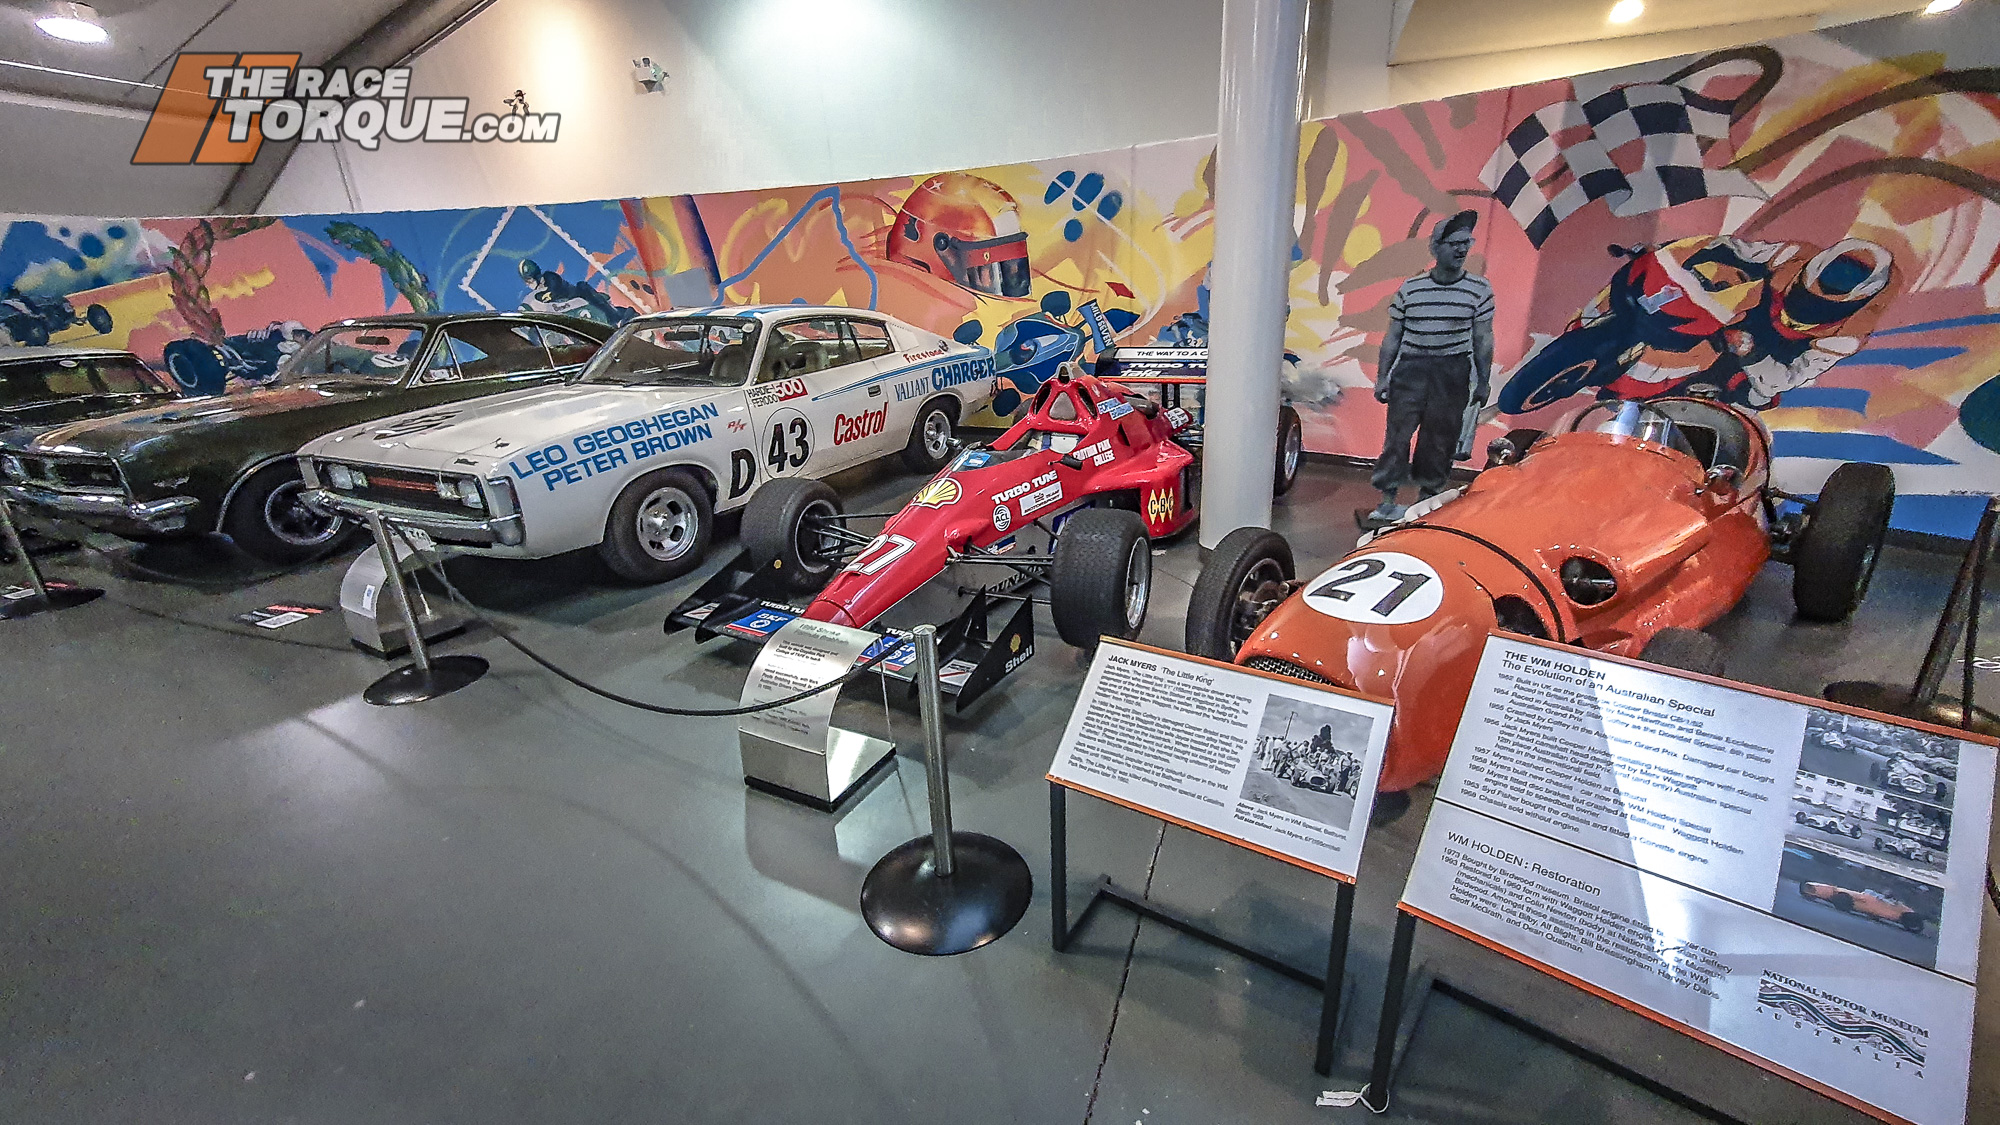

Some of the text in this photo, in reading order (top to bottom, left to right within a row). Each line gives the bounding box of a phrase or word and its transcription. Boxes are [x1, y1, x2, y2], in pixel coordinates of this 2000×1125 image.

[774, 379, 804, 398] 500
[894, 356, 996, 402] VALIANT CHARGER
[509, 402, 719, 479] LEO GEOGHEGAN
[768, 417, 809, 473] 43
[834, 402, 888, 446] Castrol
[543, 422, 712, 491] PETER BROWN
[729, 448, 756, 500] D
[991, 481, 1031, 504] TURBO
[1032, 470, 1058, 488] TUNE
[995, 513, 1010, 524] ACL
[841, 533, 917, 576] 27
[1307, 559, 1432, 617] 21
[1004, 645, 1034, 674] Shell
[1108, 655, 1129, 665] JACK
[1130, 660, 1157, 671] MYERS
[1177, 671, 1194, 680] Little
[1504, 651, 1605, 680] THE WM HOLDEN
[1501, 660, 1715, 718] The Evolution of an Australian Special
[1502, 722, 1518, 731] Jack
[1519, 728, 1541, 738] Myers
[1558, 739, 1586, 751] Cooper
[1514, 716, 1554, 732] Jack Myers
[1487, 769, 1509, 781] Myers
[1489, 761, 1512, 772] Myers
[1545, 768, 1573, 781] Cooper
[1574, 776, 1603, 789] Holden
[1510, 785, 1525, 794] sold
[1520, 798, 1546, 812] bought
[1508, 804, 1524, 814] sold
[1525, 810, 1551, 823] without
[1447, 831, 1469, 846] WM
[1531, 863, 1602, 897] Restoration
[1462, 854, 1487, 869] Bought
[1499, 868, 1535, 887] Birdwood
[1574, 897, 1600, 912] Bristol
[1601, 908, 1630, 925] engine
[1508, 890, 1523, 900] and
[1524, 896, 1544, 909] Colin
[1546, 905, 1577, 922] Newton
[1449, 893, 1470, 906] Geoff
[1506, 917, 1521, 927] and
[1522, 923, 1544, 936] Dean
[1460, 862, 1492, 879] Restored
[1522, 887, 1540, 898] form
[1542, 894, 1558, 905] with
[1595, 914, 1626, 932] Holden
[1700, 956, 1733, 975] Jeffery
[1452, 885, 1478, 900] Holden
[1581, 937, 1594, 948] Bill
[1657, 969, 1691, 989] Harvey
[1490, 892, 1524, 911] Amongst
[1525, 906, 1547, 920] those
[1612, 941, 1658, 965] restoration
[1690, 972, 1709, 985] WM
[1762, 969, 1929, 1039] NATIONAL MOTOR MUSEUM
[1755, 1006, 1925, 1079] AUSTRALIA
